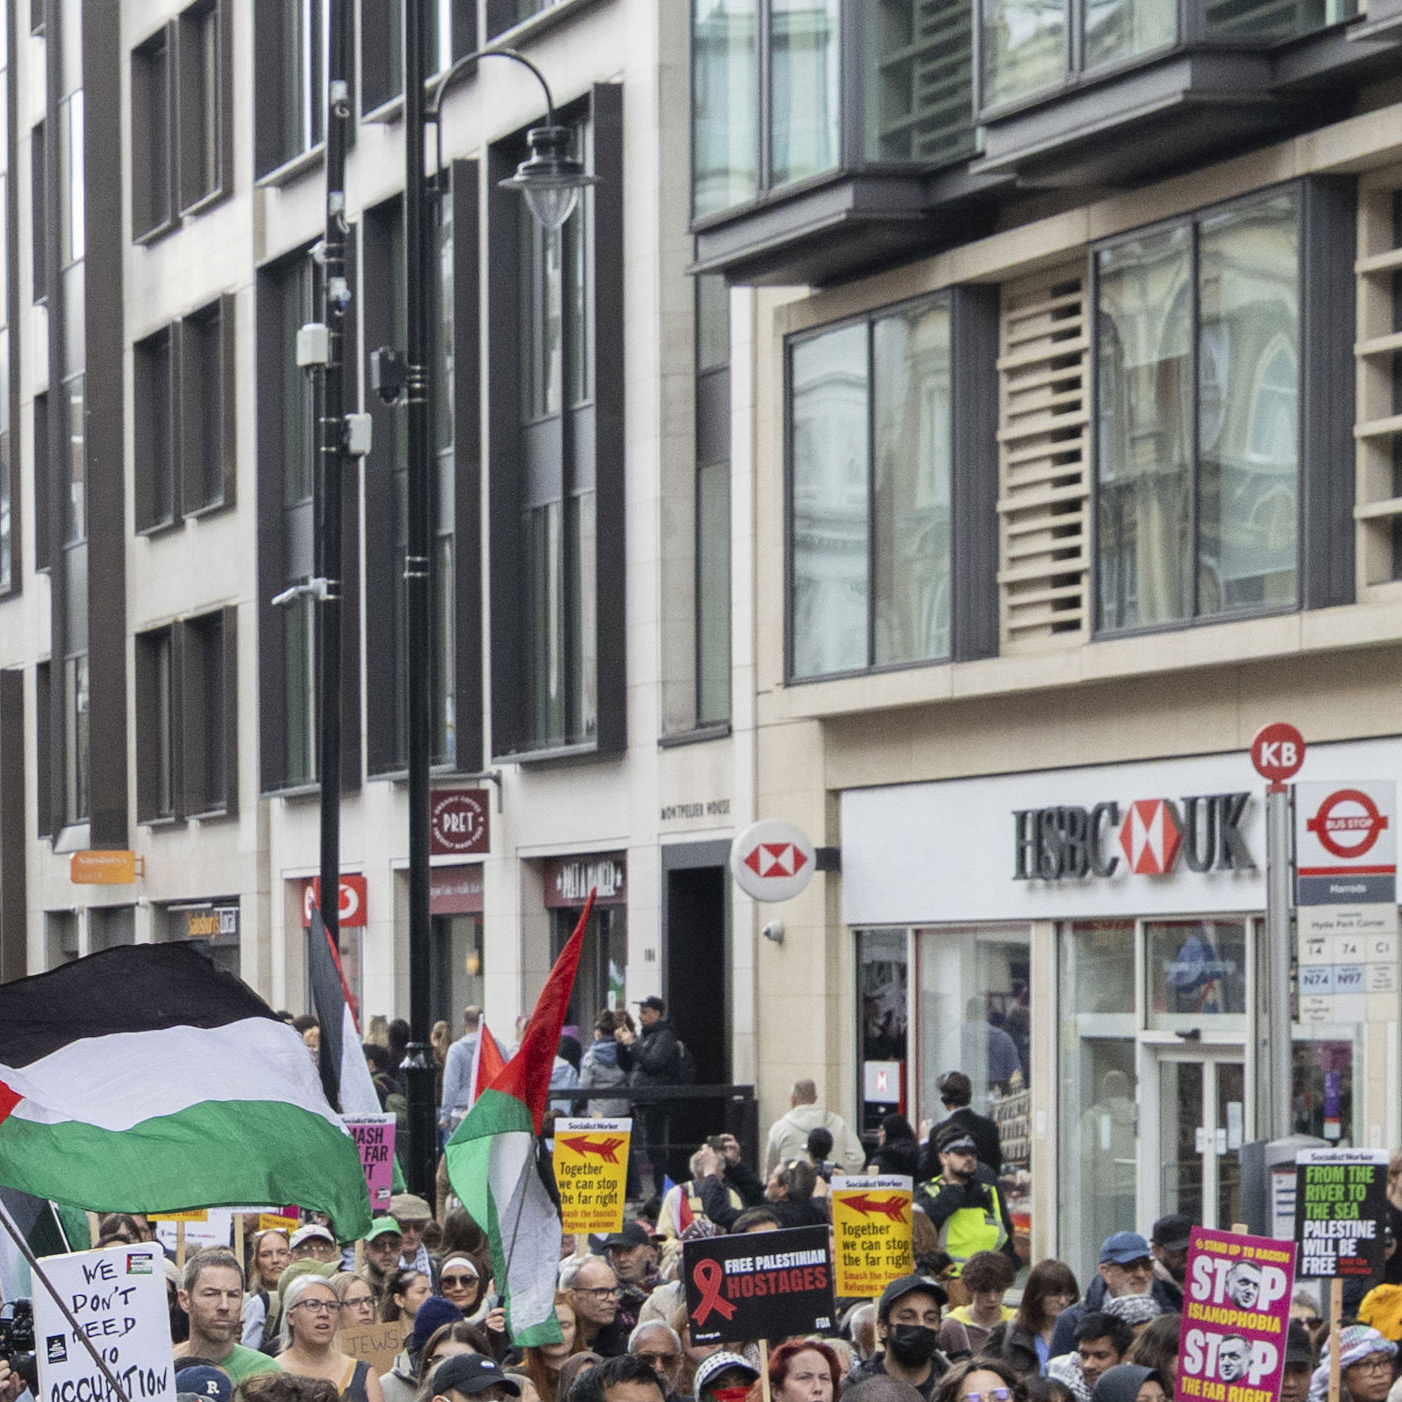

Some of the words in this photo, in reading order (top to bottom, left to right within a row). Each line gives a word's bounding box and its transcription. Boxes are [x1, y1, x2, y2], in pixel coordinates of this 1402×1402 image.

[1260, 741, 1297, 767] KB
[707, 799, 730, 814] HOUSE
[443, 812, 474, 833] PRET
[1326, 818, 1346, 830] BUS
[1347, 817, 1374, 829] STOP
[1012, 801, 1119, 881] HSBC
[1180, 792, 1257, 873] UK
[1330, 883, 1367, 894] Harrods
[1312, 920, 1333, 930] Hyde
[1336, 920, 1354, 928] Park
[1356, 919, 1385, 928] Corner
[1342, 944, 1356, 954] 74
[1304, 975, 1329, 986] N74
[1337, 974, 1361, 984] N97
[365, 1145, 388, 1162] FAR
[560, 1161, 603, 1177] Together
[1306, 1166, 1345, 1183] FROM
[1348, 1166, 1375, 1183] THE
[576, 1179, 594, 1190] can
[597, 1177, 618, 1192] stop
[1305, 1184, 1344, 1201] RIVER
[1348, 1184, 1367, 1201] TO
[577, 1192, 592, 1205] far
[595, 1191, 618, 1207] right
[1305, 1202, 1330, 1219] THE
[1334, 1202, 1359, 1219] SEA
[841, 1222, 890, 1237] Together
[1303, 1220, 1376, 1238] PALESTINE
[842, 1241, 856, 1250] we
[861, 1241, 880, 1250] can
[886, 1238, 910, 1253] stop
[1303, 1239, 1336, 1256] WILL
[1338, 1238, 1357, 1256] BE
[725, 1257, 753, 1274] FREE
[756, 1249, 826, 1270] PALESTINIAN
[844, 1254, 860, 1266] the
[866, 1253, 880, 1266] far
[1302, 1257, 1336, 1275] FREE
[82, 1259, 117, 1285] WE
[727, 1266, 828, 1298] HOSTAGES
[1191, 1255, 1287, 1311] STP
[72, 1286, 137, 1314] DON'T
[815, 1318, 831, 1329] FOA
[1188, 1302, 1281, 1333] ISLAMOPHOBIA
[1184, 1329, 1278, 1385] STP
[207, 1381, 220, 1394] R
[1181, 1376, 1201, 1396] THE
[1203, 1382, 1225, 1401] FAR
